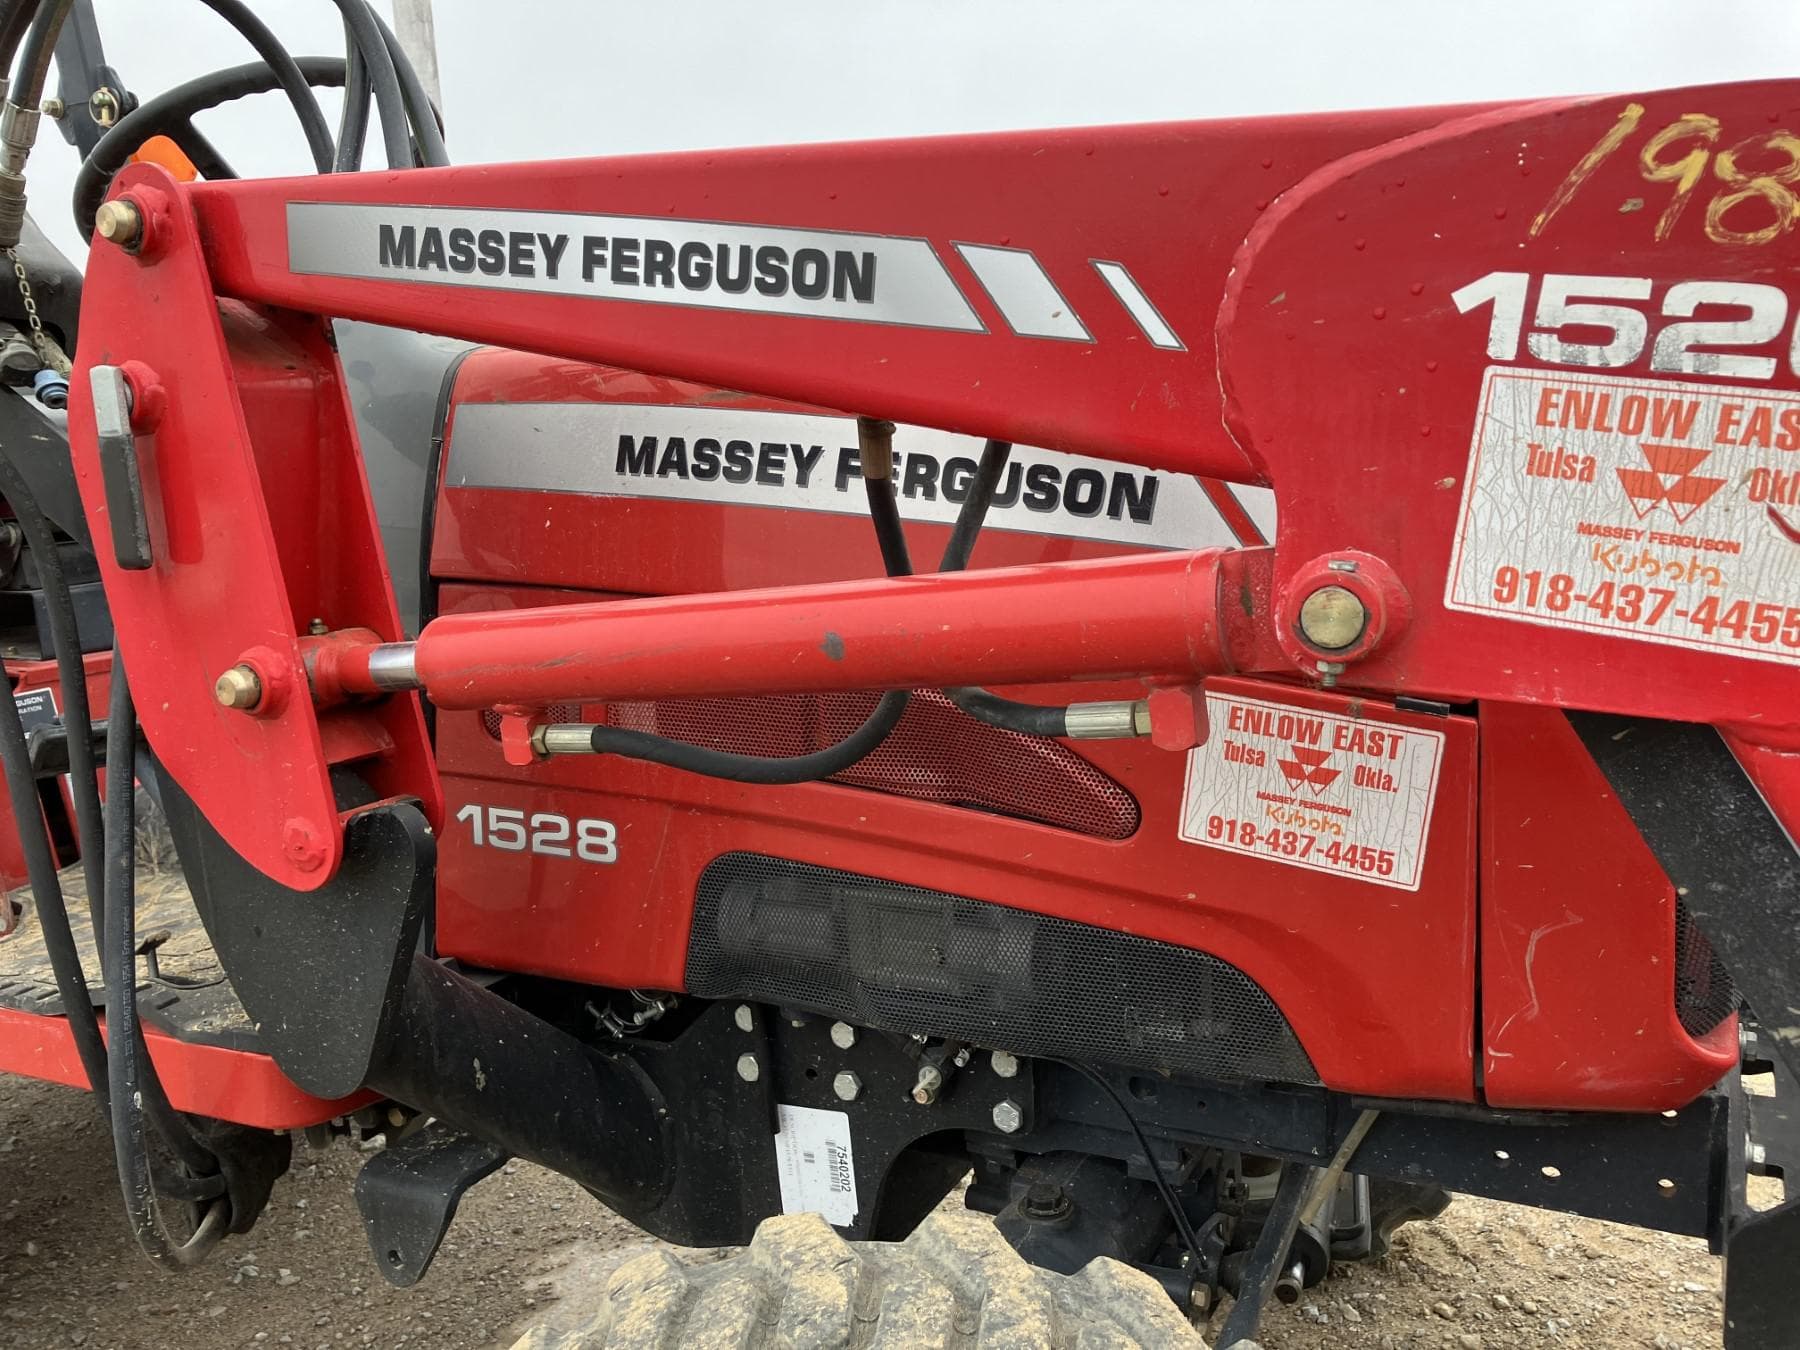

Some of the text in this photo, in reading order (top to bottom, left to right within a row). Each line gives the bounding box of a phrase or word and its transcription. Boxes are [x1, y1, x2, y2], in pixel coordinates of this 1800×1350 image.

[378, 223, 878, 304] MASSEY FERGUSON
[1451, 271, 1800, 380] 152
[1536, 388, 1800, 451] ENLOW EAS
[615, 434, 1161, 525] MASSEY FRGUSON
[1526, 443, 1800, 505] Tulsa Okl
[1577, 522, 1741, 555] MASSEY FERGUSON
[1592, 542, 1722, 588] Kubota
[1493, 566, 1800, 648] 918-437-4455
[1229, 706, 1403, 760] ENLOW EAST
[1224, 740, 1398, 793] Tulsa Okla.
[456, 804, 618, 864] 1528
[1256, 791, 1352, 817] MASSEY FERGUSON
[1266, 804, 1343, 836] Kubota
[1208, 815, 1395, 876] 918-437-4455
[836, 1146, 851, 1193] 7540202
